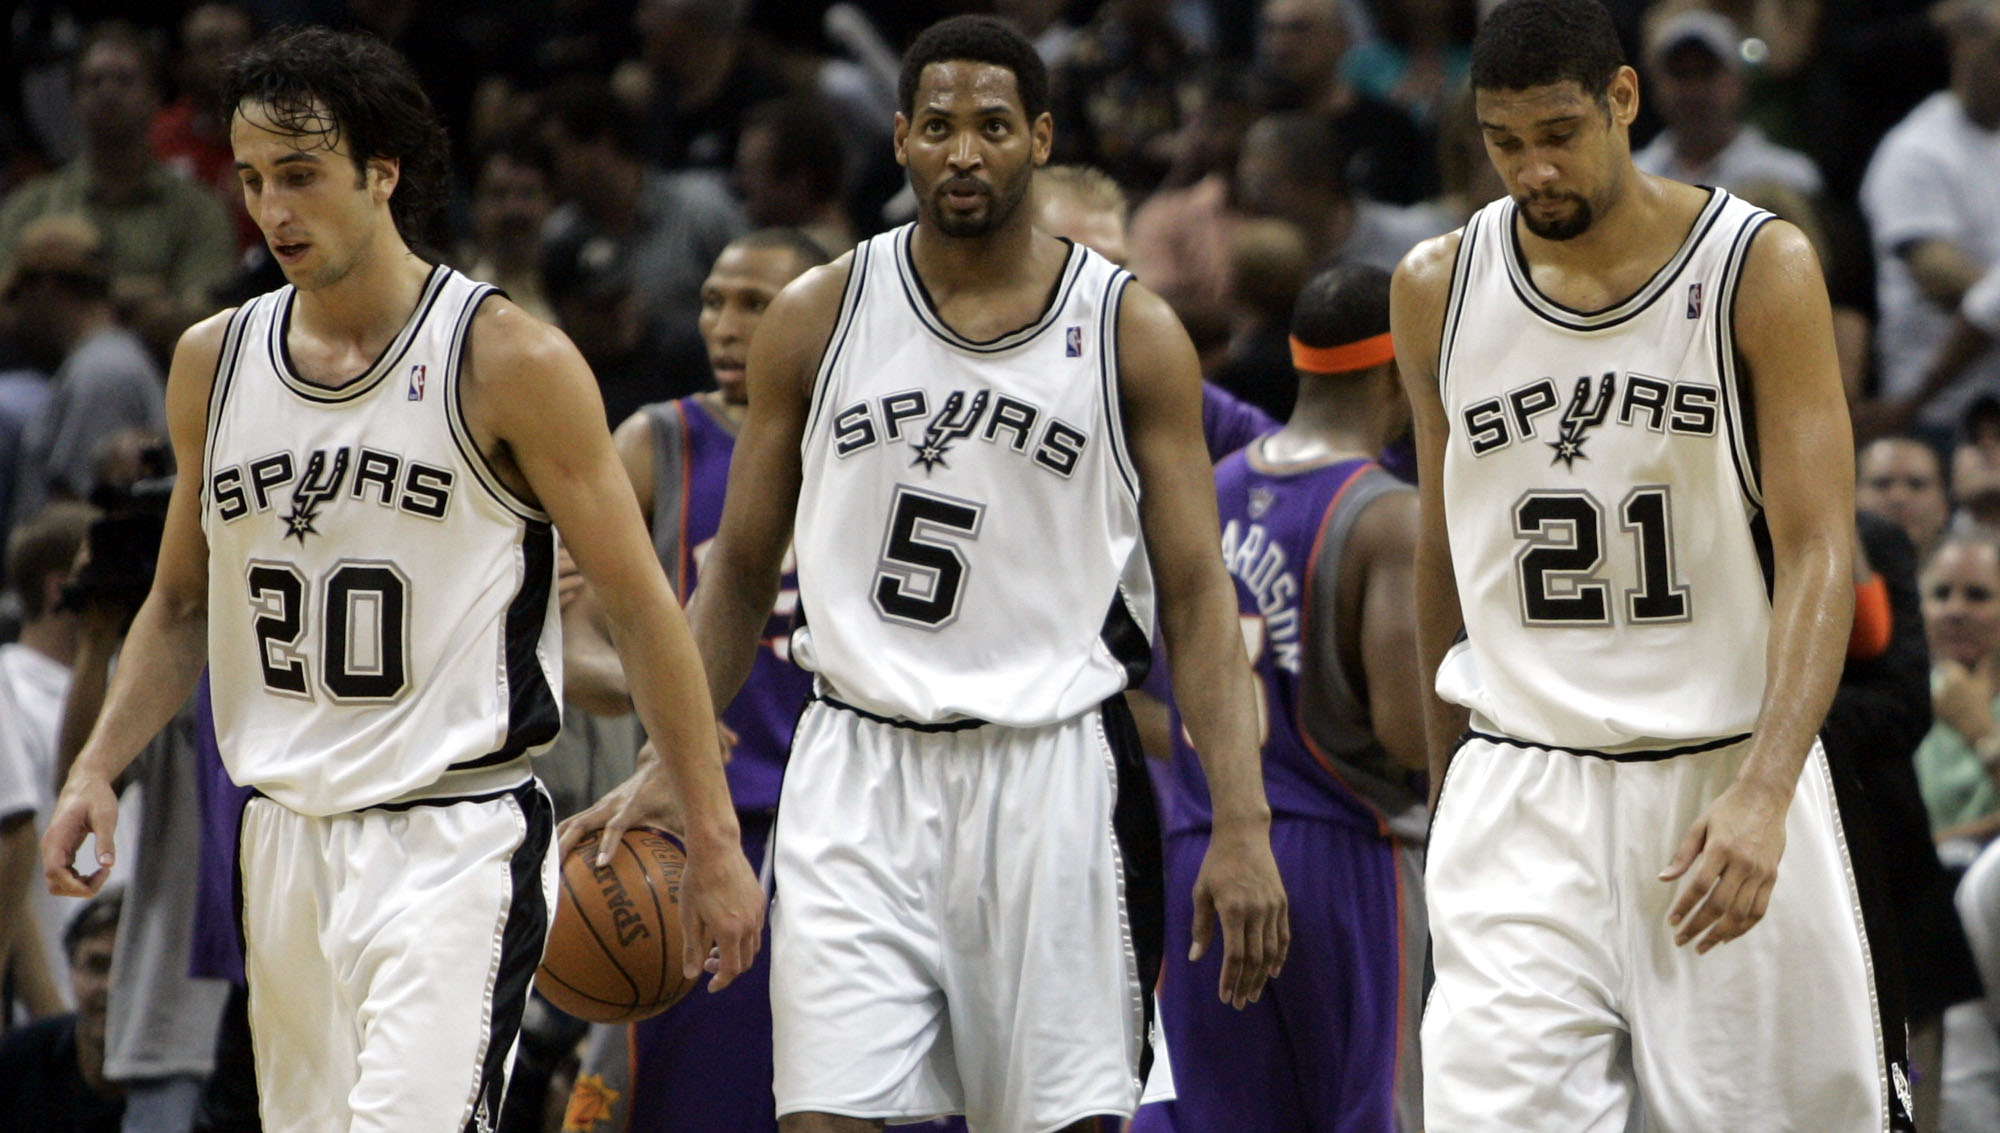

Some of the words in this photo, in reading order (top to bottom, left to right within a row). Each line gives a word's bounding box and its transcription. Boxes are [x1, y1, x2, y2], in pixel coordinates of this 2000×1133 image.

[832, 389, 1089, 480] SPURS
[1461, 371, 1720, 474] SPURS
[212, 446, 455, 549] SPURS
[868, 483, 987, 632] 5
[1511, 485, 1692, 628] 21
[246, 558, 412, 705] 20
